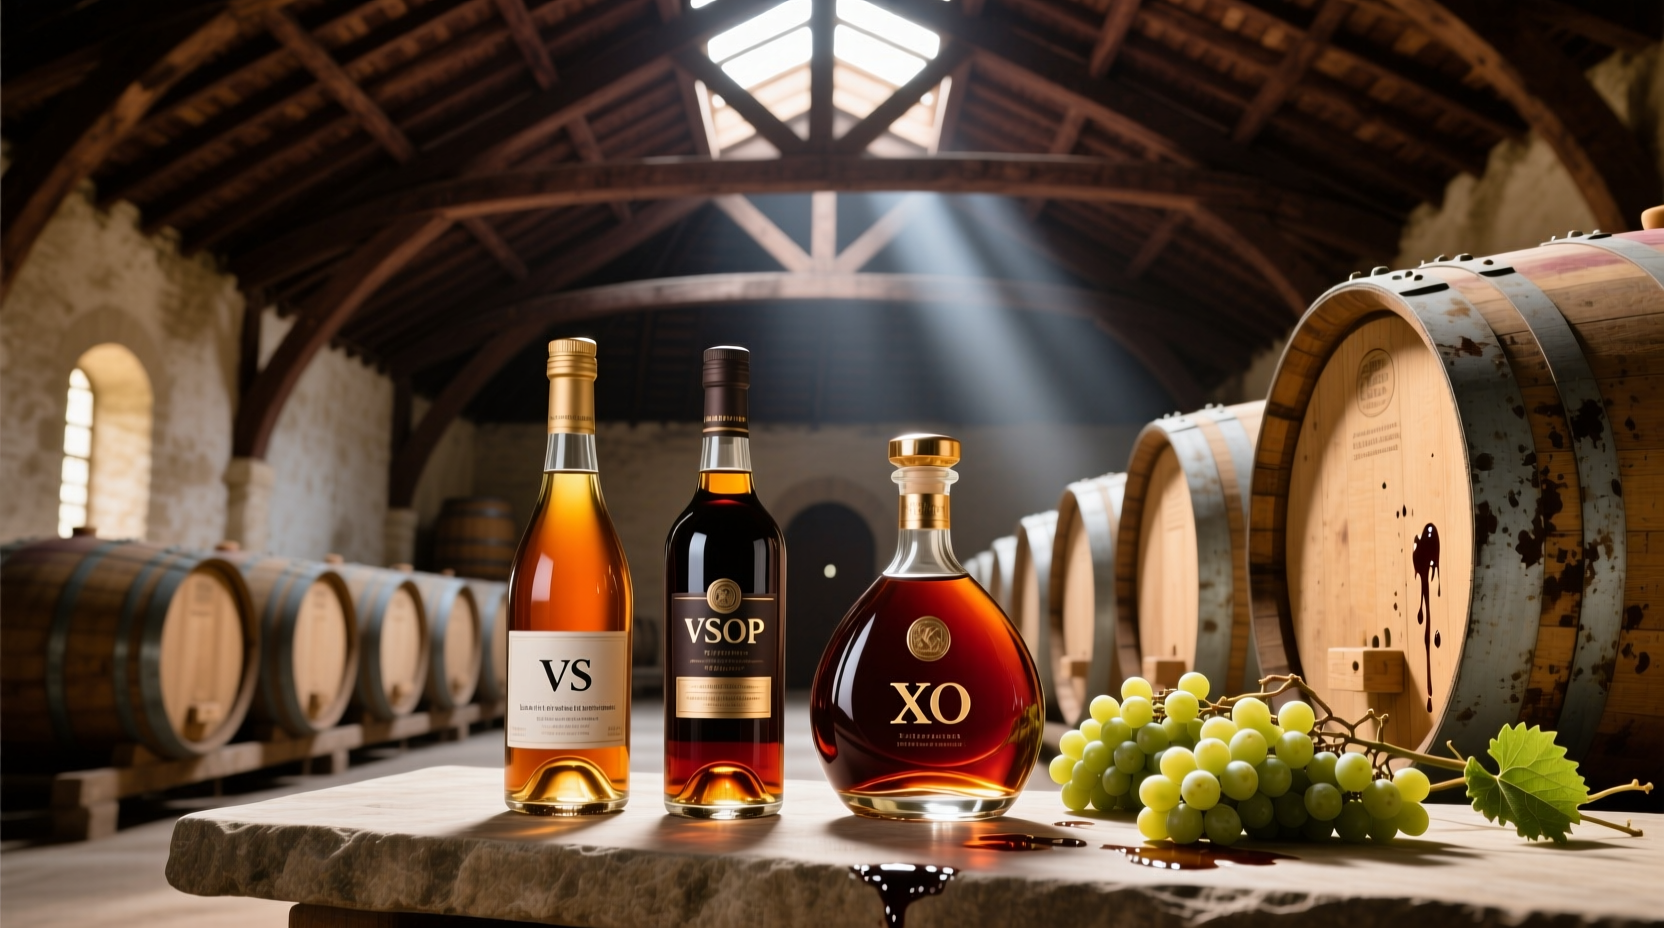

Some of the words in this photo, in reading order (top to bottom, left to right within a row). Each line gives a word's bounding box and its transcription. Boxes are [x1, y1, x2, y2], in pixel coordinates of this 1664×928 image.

[684, 617, 765, 644] VSOP
[539, 659, 592, 692] VS
[889, 682, 971, 725] XO
